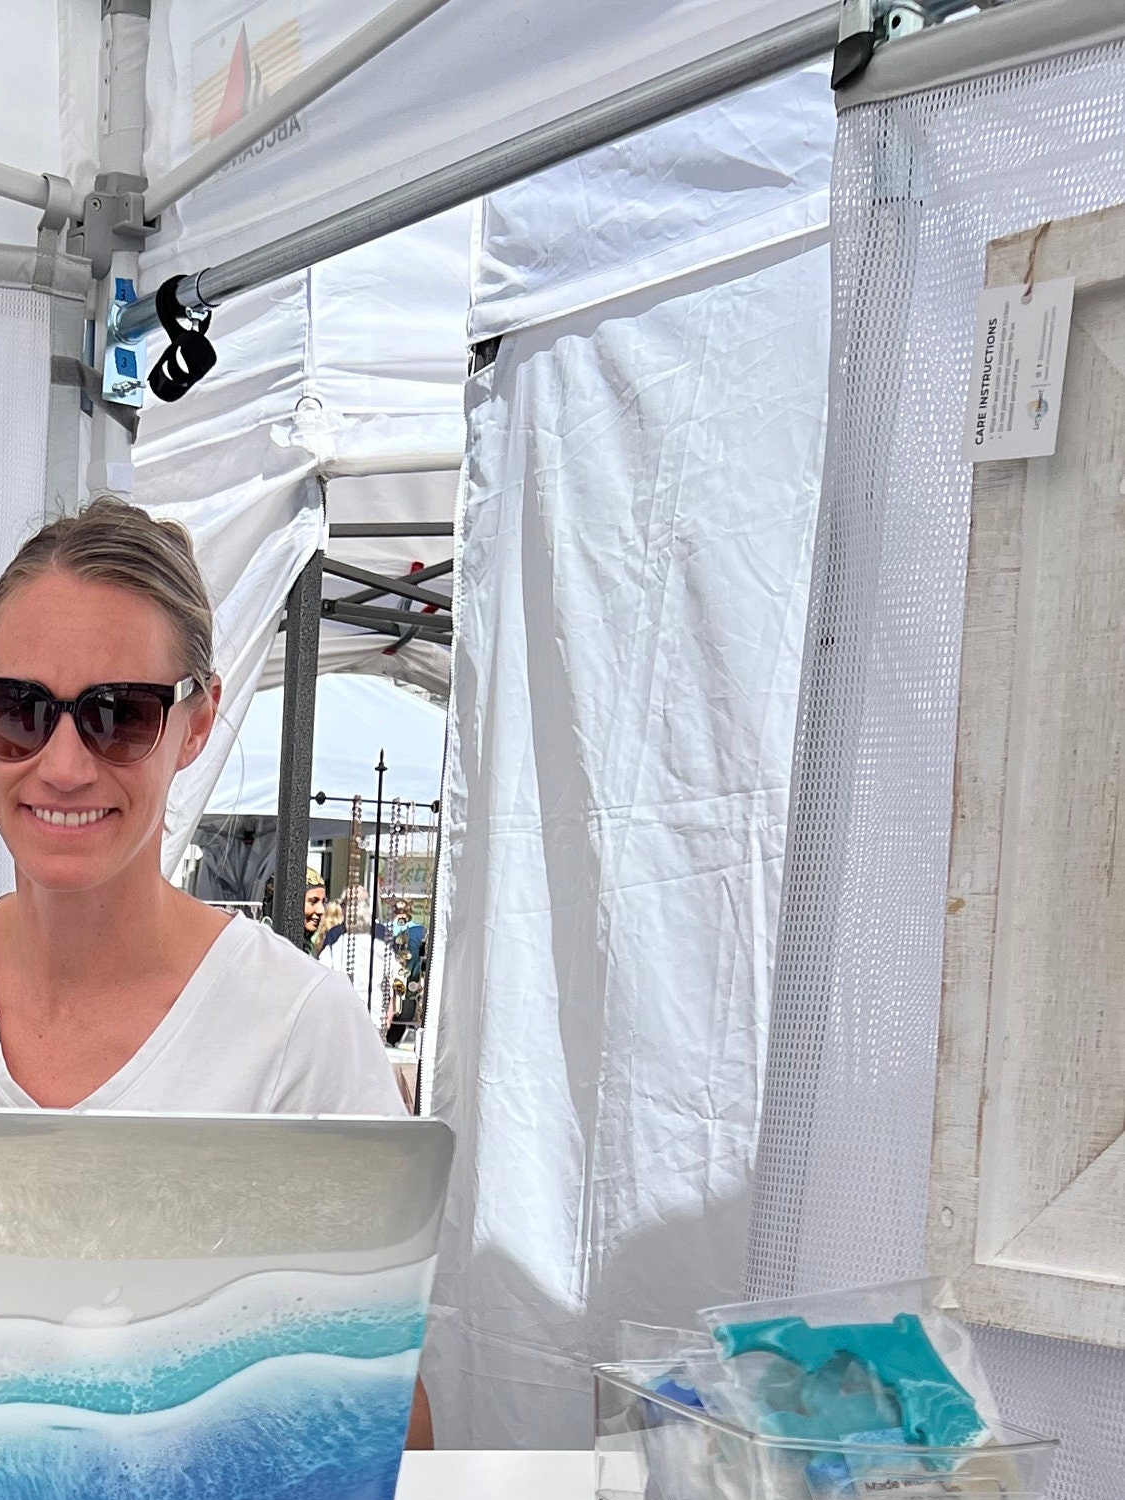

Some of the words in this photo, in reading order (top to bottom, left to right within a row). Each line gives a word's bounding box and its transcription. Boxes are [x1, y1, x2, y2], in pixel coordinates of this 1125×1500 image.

[120, 289, 126, 301] 3
[121, 356, 128, 369] 3
[979, 317, 998, 409] INSTRUCTIONS
[975, 412, 987, 445] CARE
